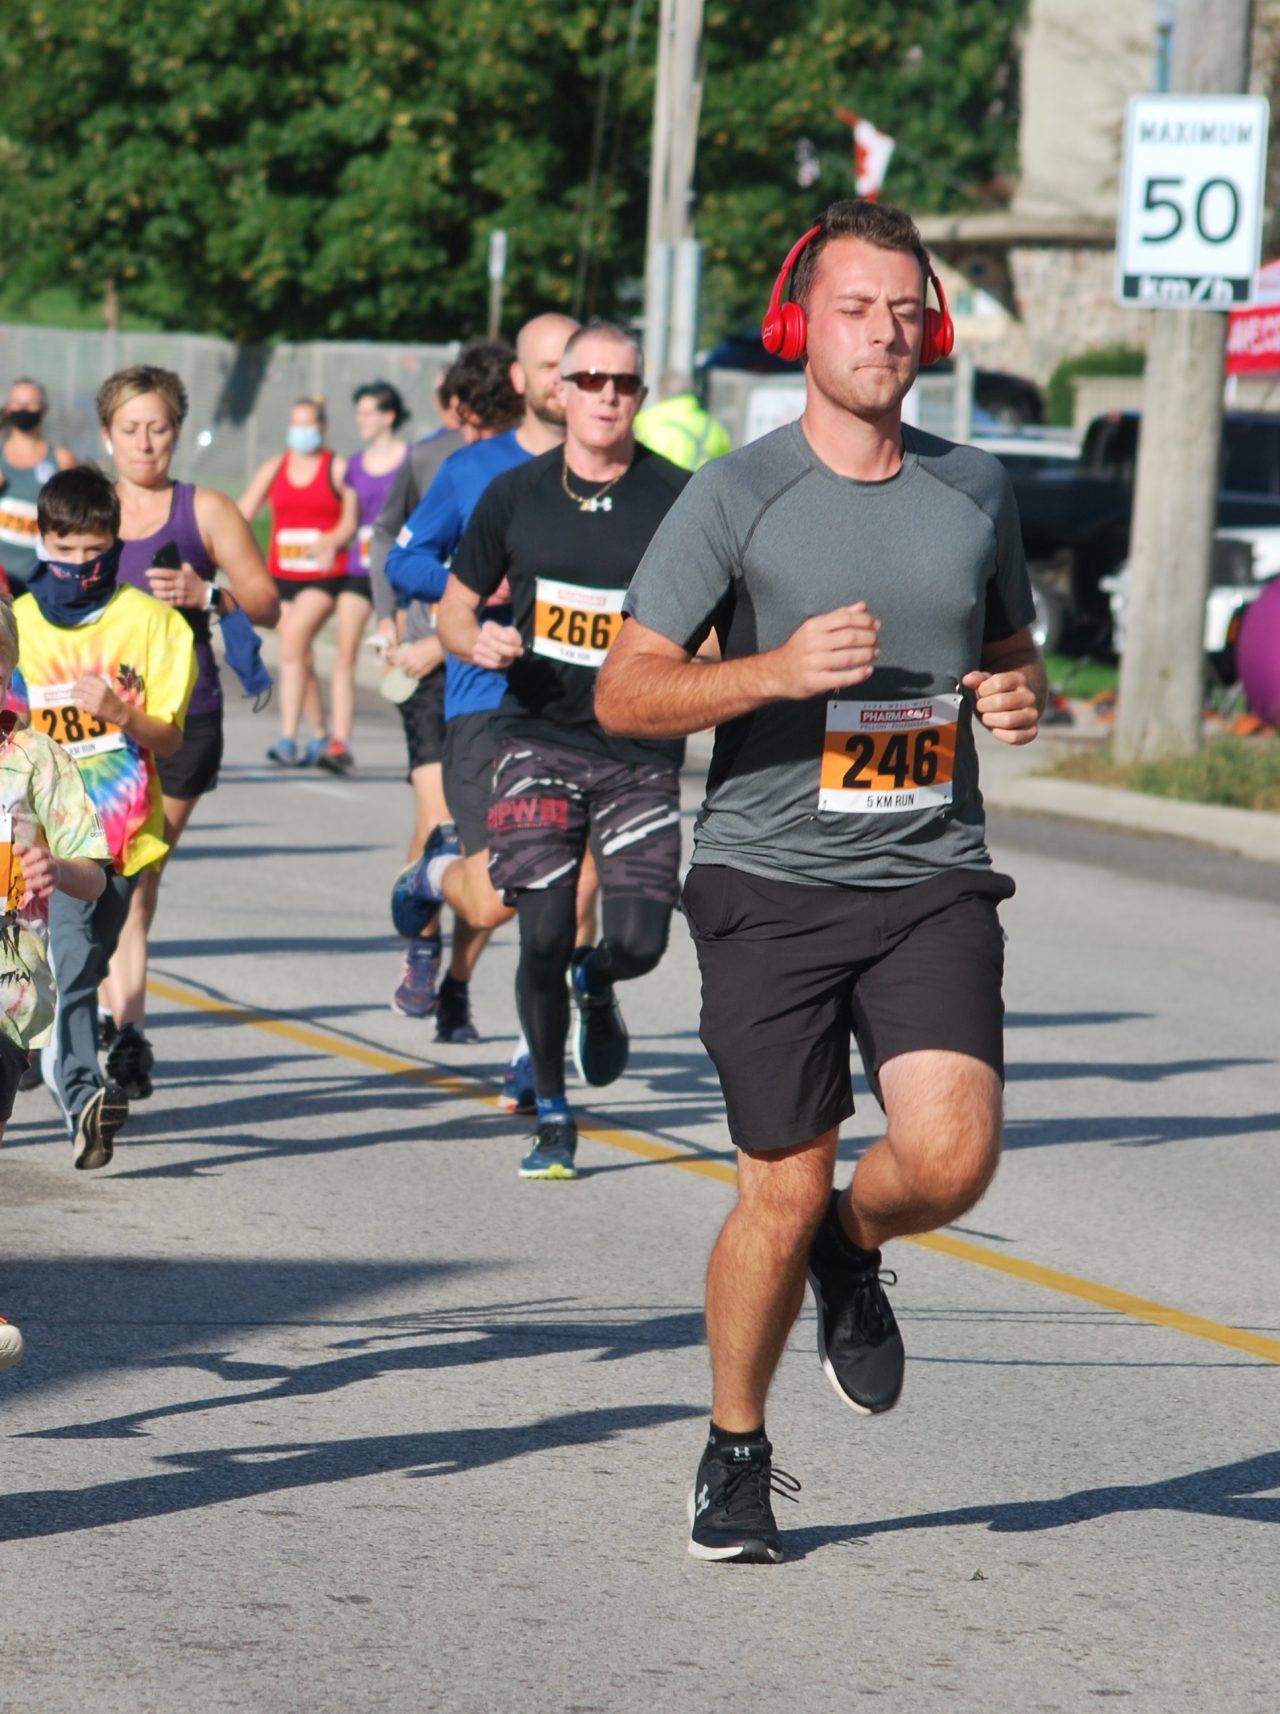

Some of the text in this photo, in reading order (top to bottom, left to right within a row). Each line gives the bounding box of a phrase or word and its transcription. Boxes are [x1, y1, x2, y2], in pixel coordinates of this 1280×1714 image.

[1139, 121, 1254, 144] MAXIMUM
[1141, 177, 1240, 244] 50
[1137, 275, 1235, 304] km/h
[547, 605, 611, 650] 266
[862, 708, 931, 721] PHARMASAVE
[842, 730, 940, 789] 246
[867, 793, 915, 808] 5 KM RUN
